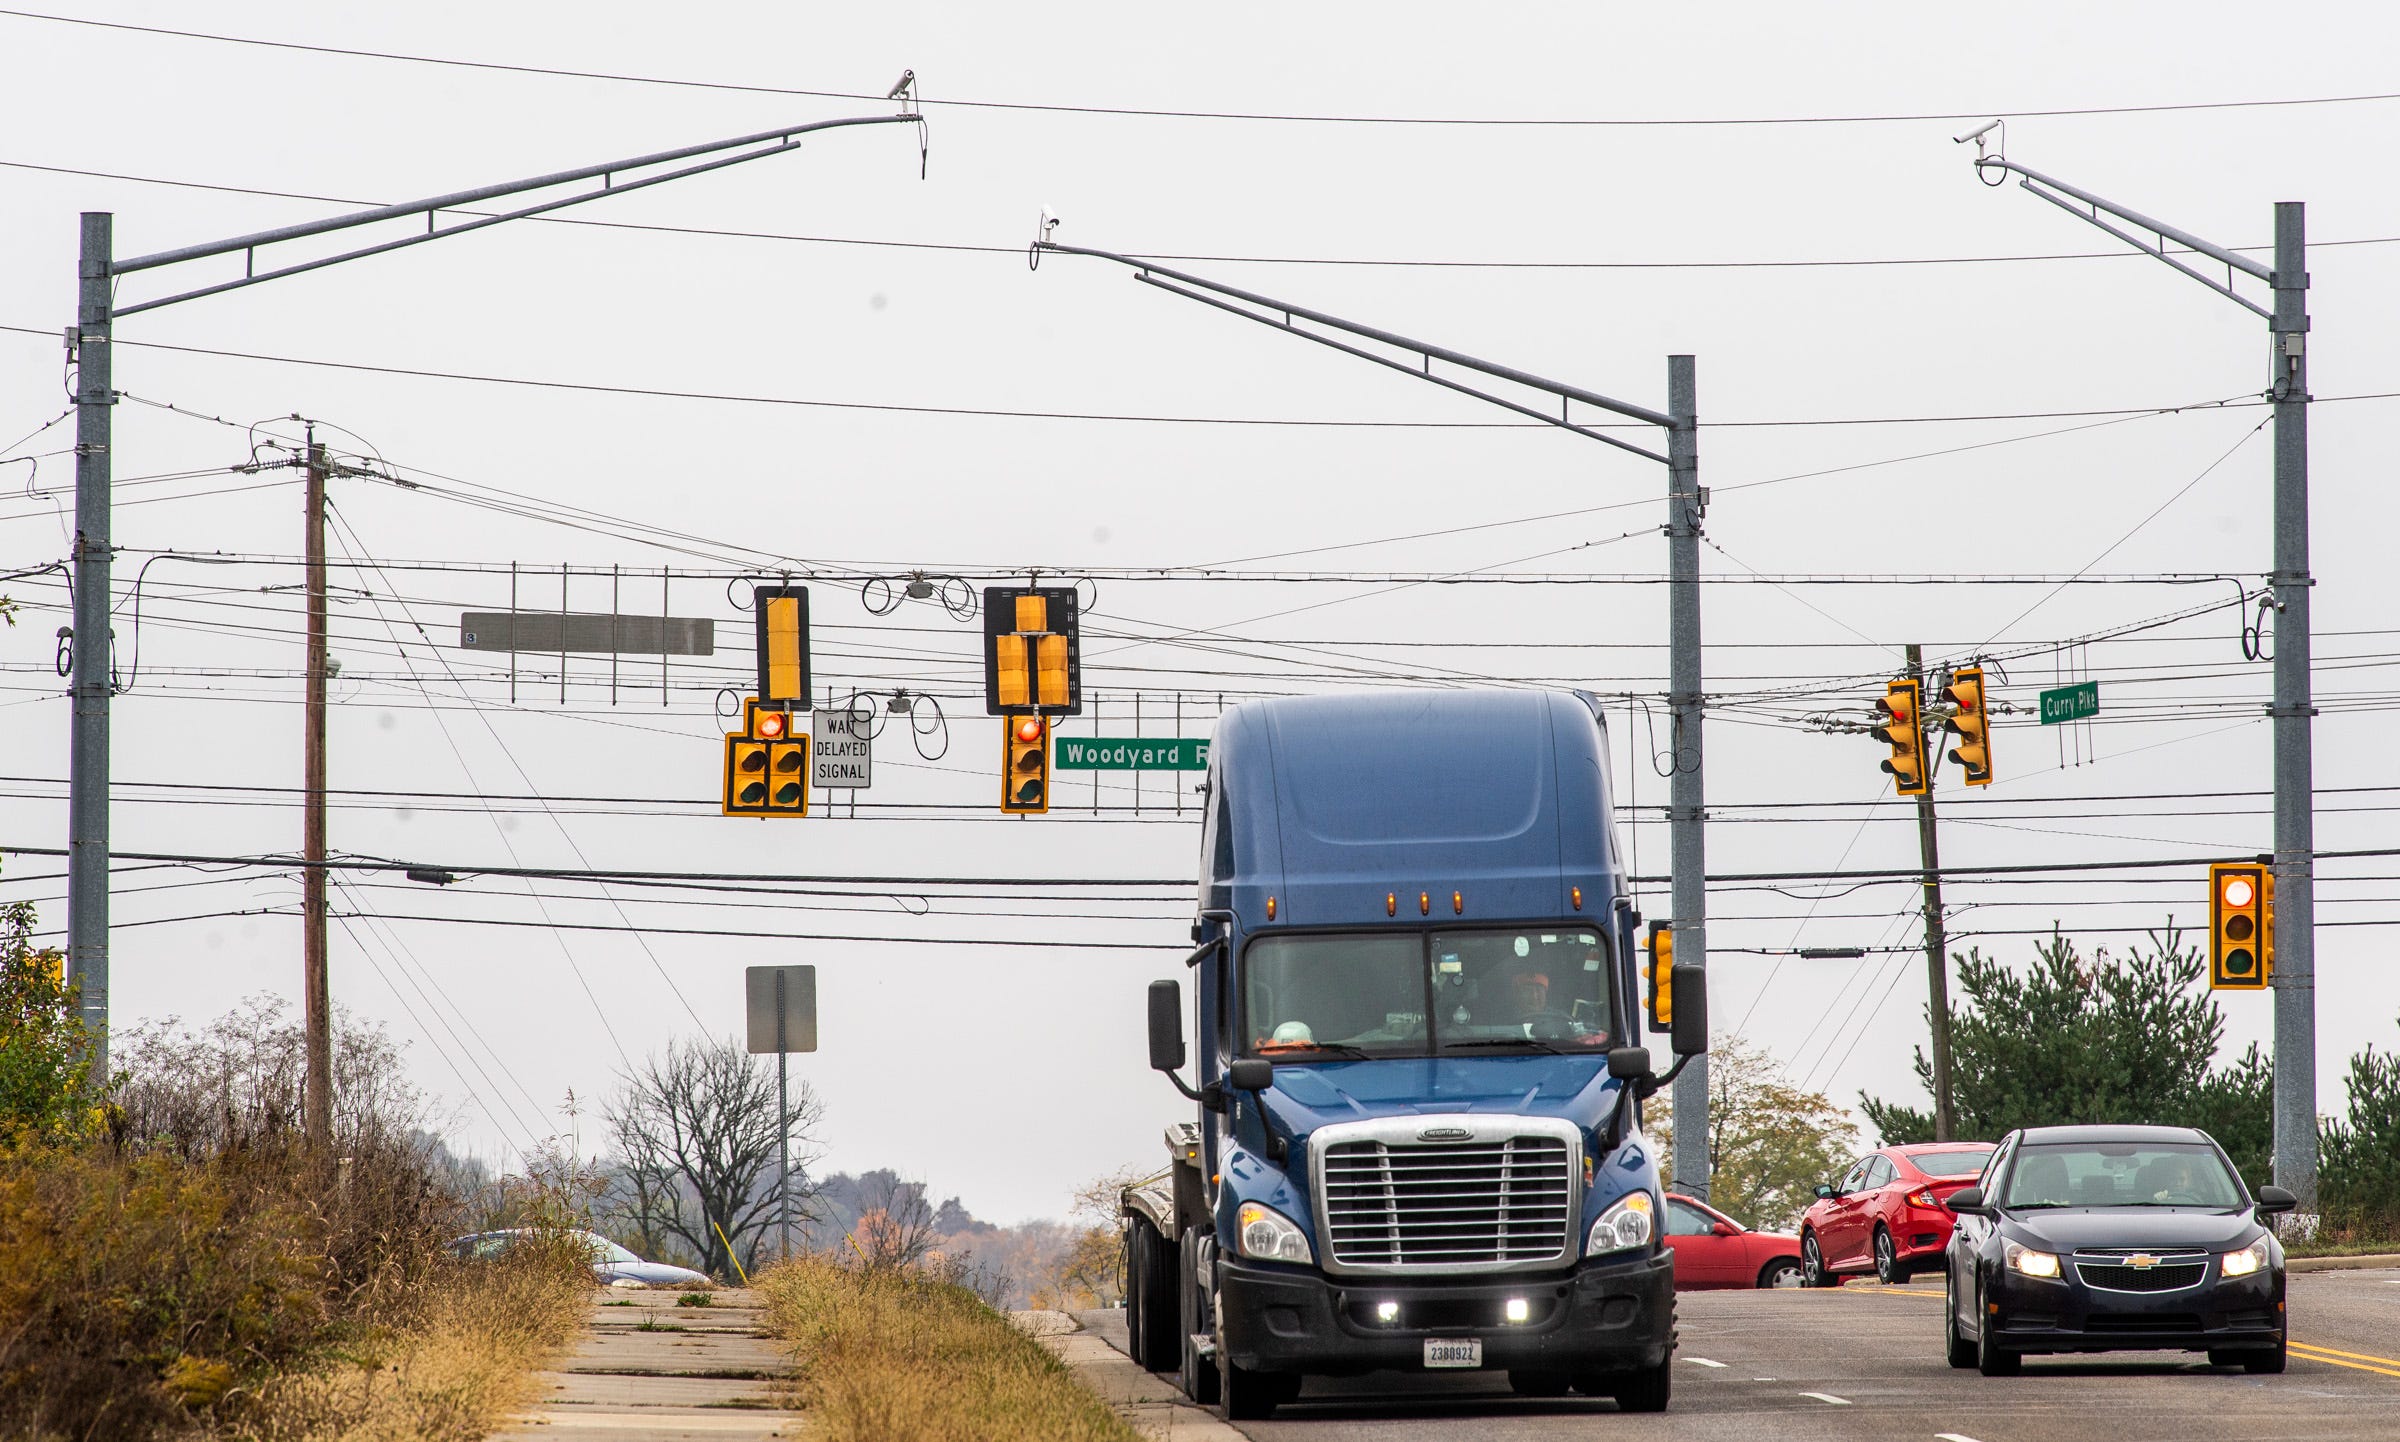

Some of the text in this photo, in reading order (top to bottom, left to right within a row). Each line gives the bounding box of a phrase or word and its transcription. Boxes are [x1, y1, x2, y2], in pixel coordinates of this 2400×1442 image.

[2046, 690, 2095, 718] Curry Pike
[827, 719, 856, 734] WAIT
[817, 741, 867, 756] DELAYED
[1066, 743, 1179, 768] Woodyard
[819, 763, 865, 778] SIGNAL
